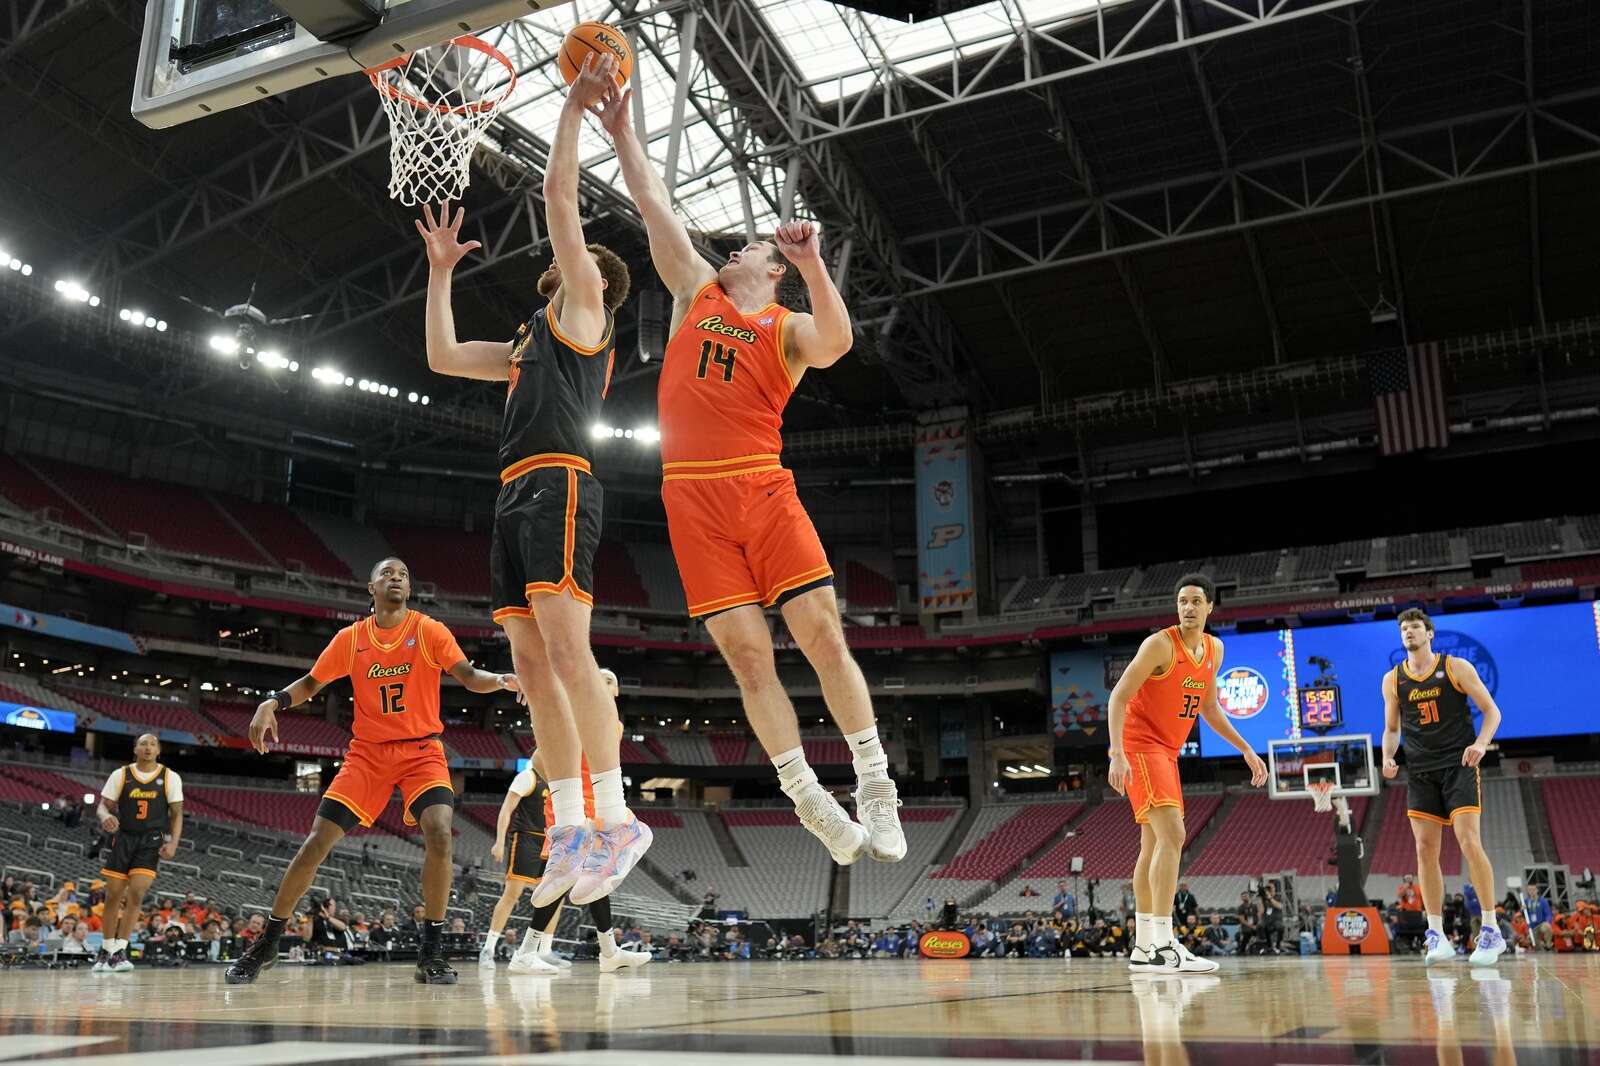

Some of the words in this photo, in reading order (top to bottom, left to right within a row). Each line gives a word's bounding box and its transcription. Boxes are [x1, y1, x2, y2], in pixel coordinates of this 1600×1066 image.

[595, 32, 627, 61] NCAA
[696, 315, 758, 344] Reese's
[696, 339, 737, 383] 14
[38, 551, 64, 567] LANE
[1485, 584, 1512, 594] RING
[1532, 578, 1573, 590] HONOR
[1289, 601, 1331, 613] ARIZONA
[1334, 596, 1394, 609] CARDINALS
[367, 662, 412, 680] Reese's
[378, 681, 407, 715] 12
[1179, 694, 1200, 718] 32
[1307, 702, 1332, 722] 22
[1417, 700, 1440, 725] 31
[136, 800, 148, 819] 3
